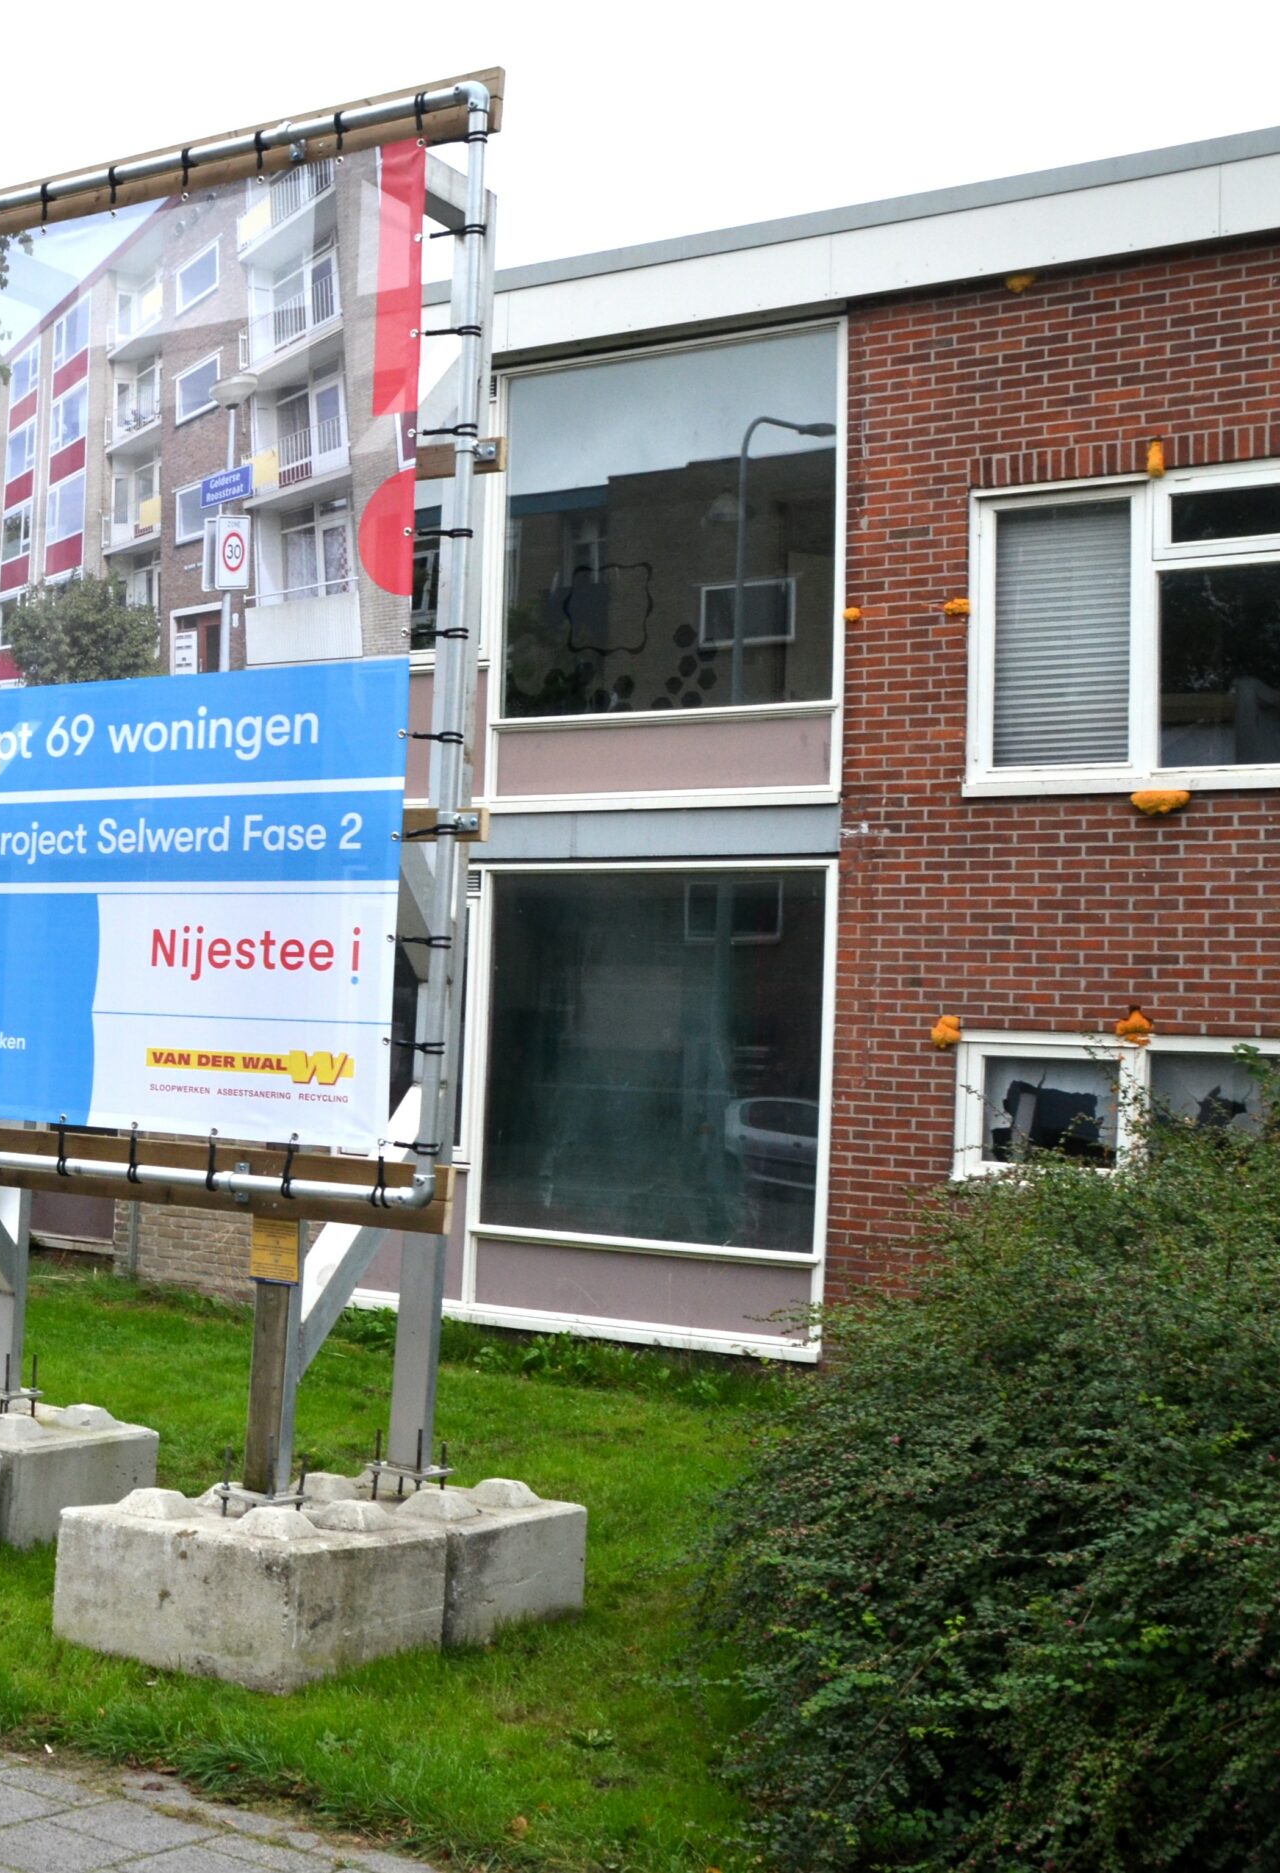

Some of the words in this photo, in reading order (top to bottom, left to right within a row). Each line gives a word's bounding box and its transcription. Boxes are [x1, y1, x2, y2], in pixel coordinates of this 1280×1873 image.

[209, 472, 241, 489] Gelderse
[206, 483, 244, 503] Roosstraat
[226, 544, 242, 560] 30
[46, 714, 95, 758] 69
[108, 706, 319, 761] woningen
[97, 815, 230, 854] Selwerd
[242, 814, 327, 851] Fase
[338, 812, 363, 850] 2
[151, 926, 334, 981] Nijestee
[152, 1052, 191, 1066] VAN
[197, 1054, 236, 1069] DER
[242, 1057, 288, 1071] WAL
[149, 1083, 211, 1095] SLOOPWERKEN
[216, 1088, 291, 1100] ASBESTSANERING
[298, 1093, 349, 1104] RECYCLING
